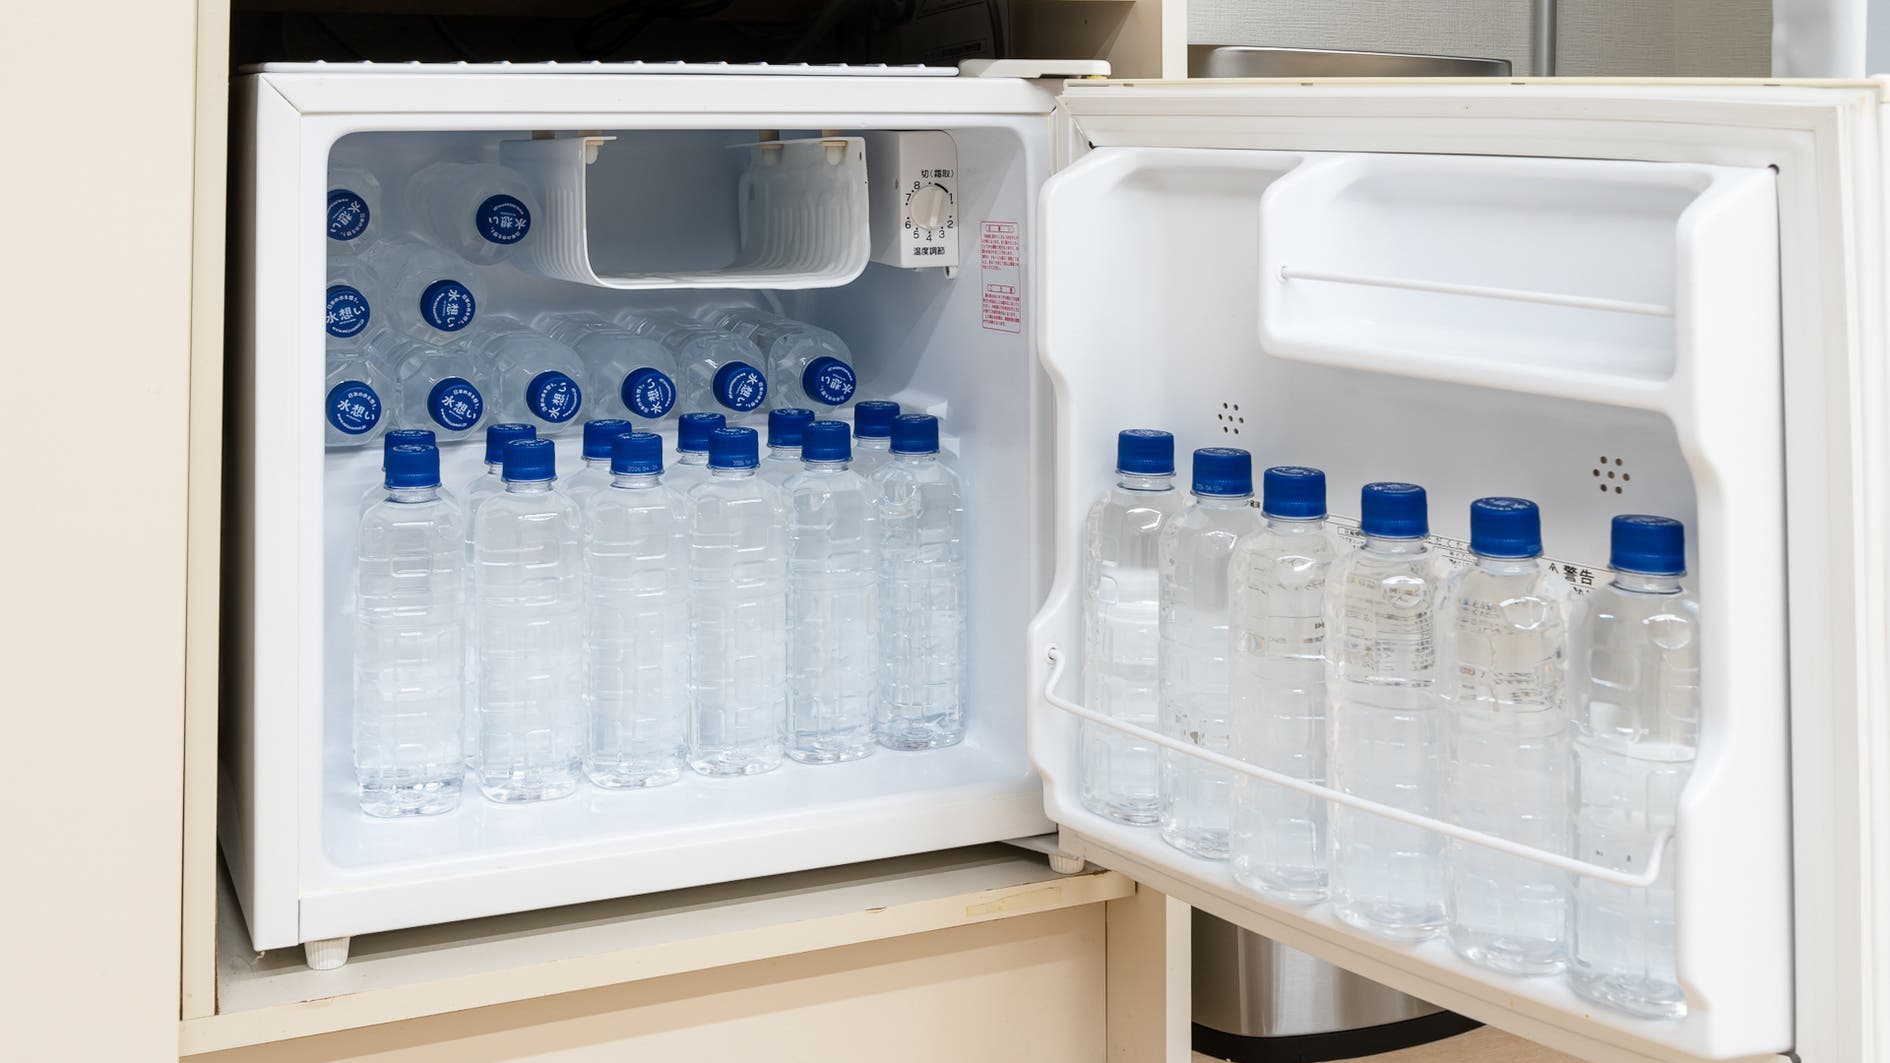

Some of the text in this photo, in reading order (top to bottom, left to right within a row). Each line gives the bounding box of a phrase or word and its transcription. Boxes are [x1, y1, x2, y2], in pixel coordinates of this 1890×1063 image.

[914, 181, 920, 190] 8
[905, 194, 912, 202] 7
[330, 200, 360, 232] 水想い
[488, 216, 527, 228] 水想い
[947, 220, 954, 228] 2
[913, 230, 920, 239] 5
[926, 234, 932, 242] 4
[938, 230, 945, 238] 3
[913, 246, 945, 256] 温度調節
[447, 288, 461, 328] 水想い
[736, 372, 758, 406] 水想い
[820, 376, 853, 394] 水想い
[548, 382, 567, 418] 水想い
[647, 378, 662, 413] 水想い
[337, 399, 376, 420] 水想い
[442, 394, 476, 419] 水想い
[1563, 564, 1595, 586] 警告
